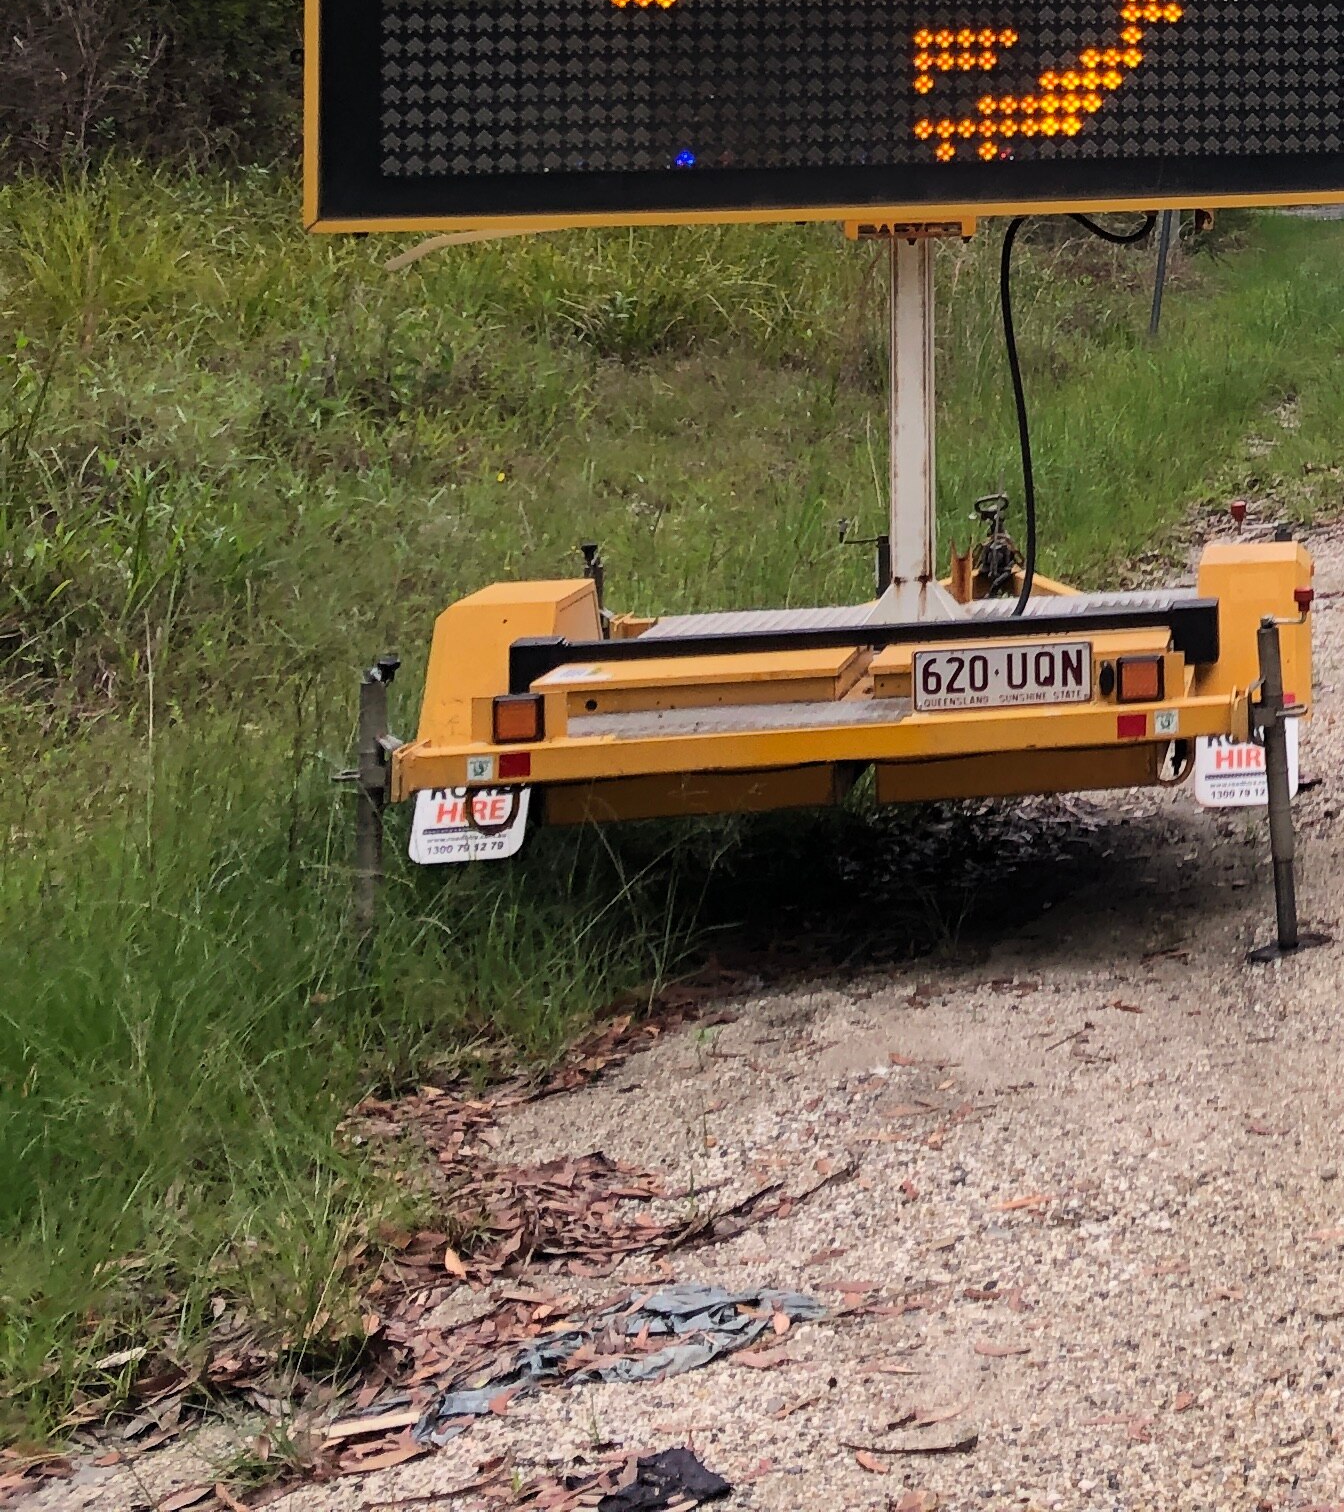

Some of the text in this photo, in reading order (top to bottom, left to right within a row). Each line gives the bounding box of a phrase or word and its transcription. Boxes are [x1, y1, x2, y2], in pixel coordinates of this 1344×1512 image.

[923, 689, 1081, 708] QUEENSLAND SUNSHINE STATE
[1216, 748, 1264, 769] HIR
